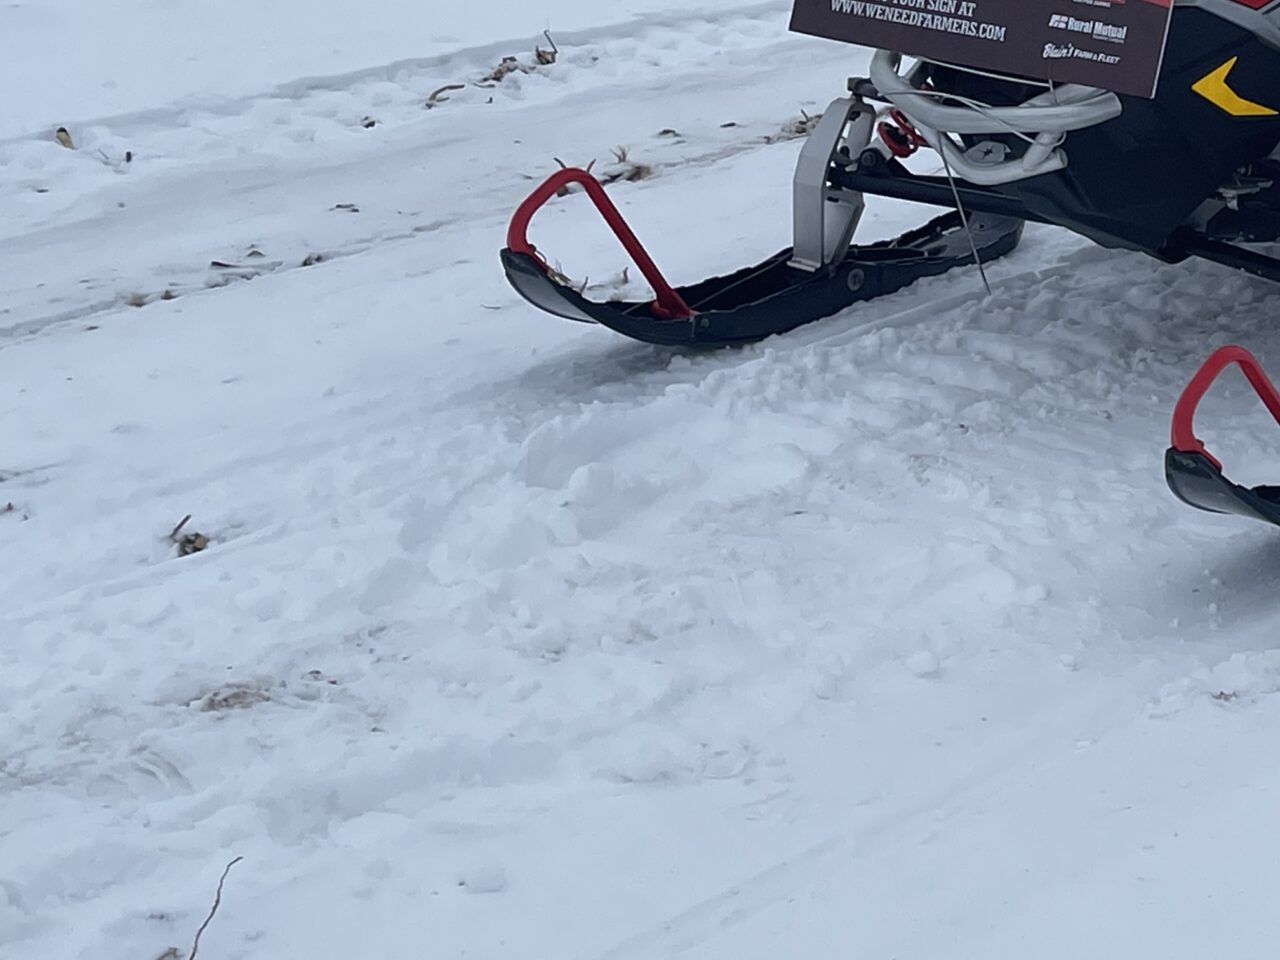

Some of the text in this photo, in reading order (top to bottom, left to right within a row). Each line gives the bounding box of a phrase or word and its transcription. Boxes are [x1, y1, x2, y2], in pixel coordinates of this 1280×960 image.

[957, 0, 977, 18] AT
[1067, 16, 1094, 34] Rural
[1093, 21, 1128, 39] Mutual
[1097, 53, 1121, 64] FLEET
